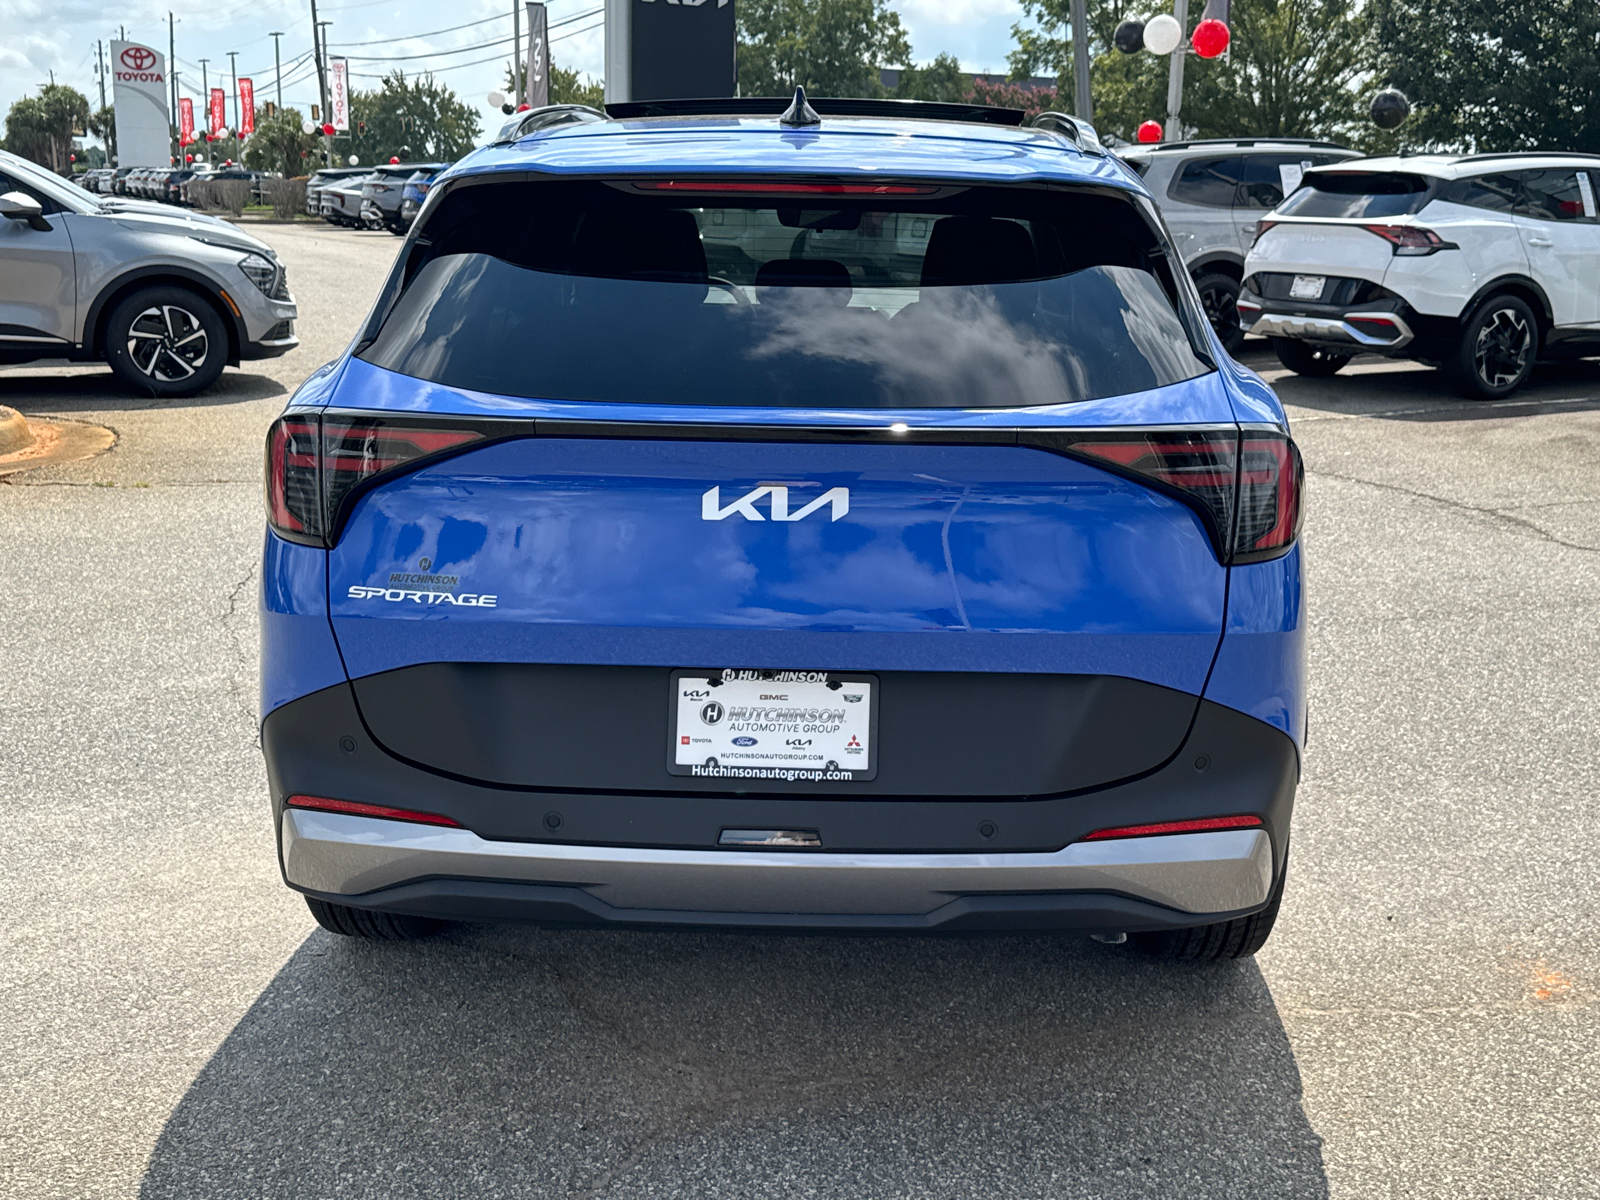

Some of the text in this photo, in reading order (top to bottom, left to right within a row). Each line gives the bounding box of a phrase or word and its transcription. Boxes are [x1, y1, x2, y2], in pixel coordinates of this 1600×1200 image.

[115, 71, 164, 83] TOYOTA
[335, 73, 344, 126] TOYOTA
[243, 89, 251, 132] TOYOTA
[183, 107, 191, 141] TOYOTA
[702, 485, 849, 523] KIA
[389, 573, 458, 585] HUTCHINSON
[390, 583, 430, 591] AUTOMOTIVE
[348, 585, 498, 607] SPORTAGE
[738, 670, 828, 683] HUHINSON
[727, 707, 846, 724] HUTCHINSON
[729, 722, 840, 734] AUTOMOTIVE GROUP
[692, 765, 852, 782] Hutchinsonautogroup.com
